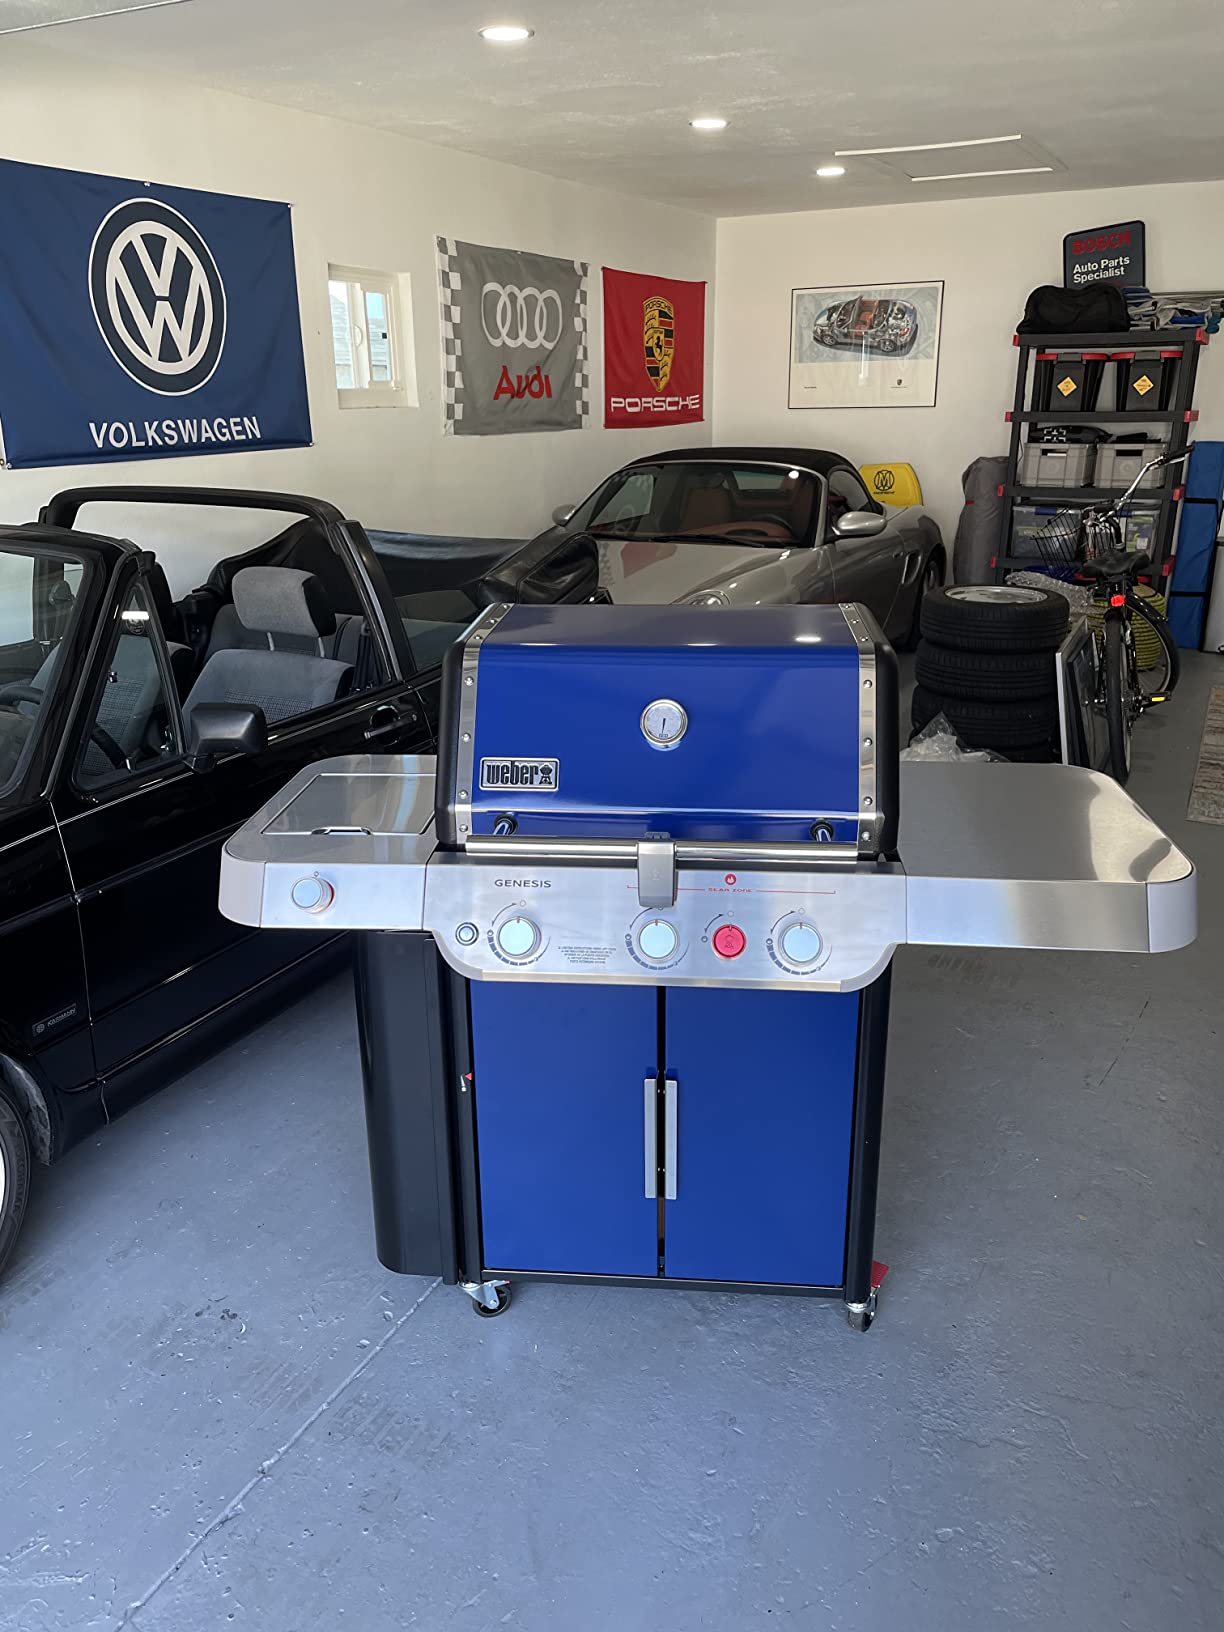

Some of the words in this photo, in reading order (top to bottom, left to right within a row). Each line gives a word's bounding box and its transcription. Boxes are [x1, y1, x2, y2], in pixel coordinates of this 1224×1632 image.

[1072, 230, 1131, 255] BOSCH
[1073, 262, 1099, 274] Auto
[1101, 256, 1130, 269] Parts
[1073, 266, 1125, 284] Specialist
[645, 300, 673, 315] PORSCHE
[493, 365, 553, 401] Audi
[610, 394, 700, 413] PORSCHE
[88, 416, 262, 449] VOLKSWAGEN
[486, 760, 539, 785] weber
[494, 879, 552, 888] GENESIS
